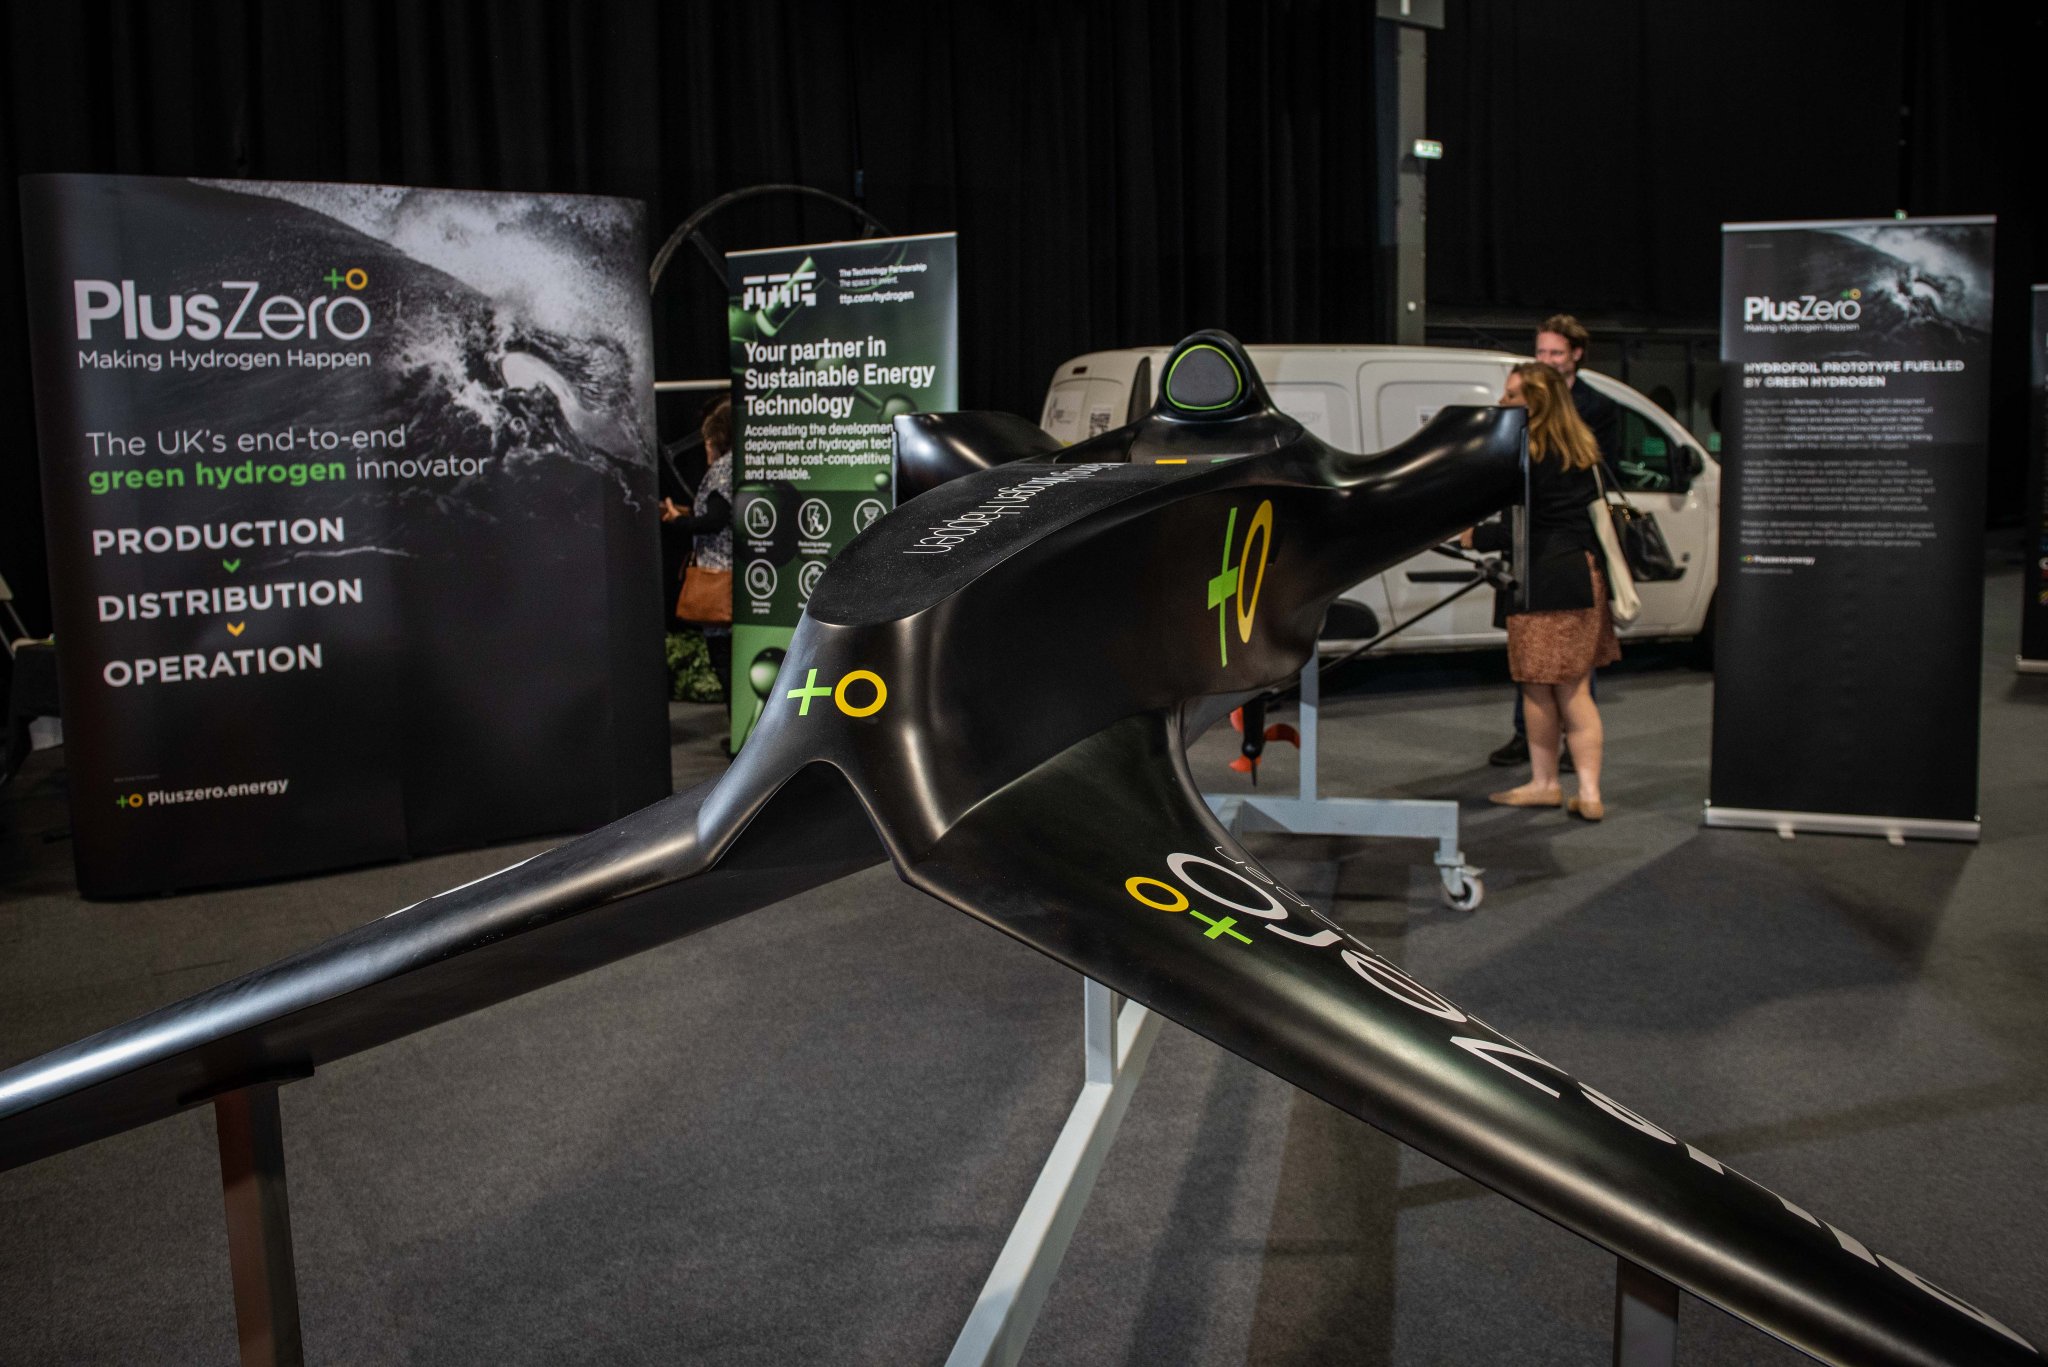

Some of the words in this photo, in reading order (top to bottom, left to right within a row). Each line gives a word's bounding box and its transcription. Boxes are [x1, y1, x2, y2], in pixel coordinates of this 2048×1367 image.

[73, 279, 371, 341] PlusZero
[1744, 296, 1861, 322] PlusZero
[78, 349, 162, 371] Making
[169, 349, 281, 371] Hydrogen
[287, 350, 371, 371] Happen
[745, 341, 788, 363] Your
[790, 338, 864, 365] partner
[867, 335, 886, 357] in
[745, 364, 859, 390] Sustainable
[863, 363, 936, 388] Energy
[1743, 361, 1820, 374] HYDROFOIL
[1822, 360, 1901, 373] PROTOTYPE
[1903, 359, 1965, 372] FUELLED
[1764, 376, 1808, 388] GREEN
[1810, 375, 1886, 387] HYDROGEN
[744, 393, 855, 419] Technology
[86, 431, 147, 457] The
[237, 424, 406, 451] end-to-end
[745, 424, 808, 438] Accelerating
[809, 423, 826, 435] the
[828, 422, 893, 436] developmen
[745, 439, 804, 453] deployment
[806, 439, 816, 450] of
[818, 438, 868, 452] hydrogen
[745, 454, 765, 466] that
[767, 453, 784, 465] will
[786, 453, 799, 465] be
[801, 452, 890, 467] cost-competitive
[89, 466, 184, 495] green
[196, 460, 346, 490] hydrogen
[356, 454, 489, 480] innovator
[745, 468, 764, 480] and
[766, 467, 811, 480] scalable.
[92, 516, 345, 556] PRODUCTION
[98, 578, 363, 622] DISTRIBUTION
[103, 643, 323, 687] OPERATION
[148, 779, 289, 806] Pluszero.energy
